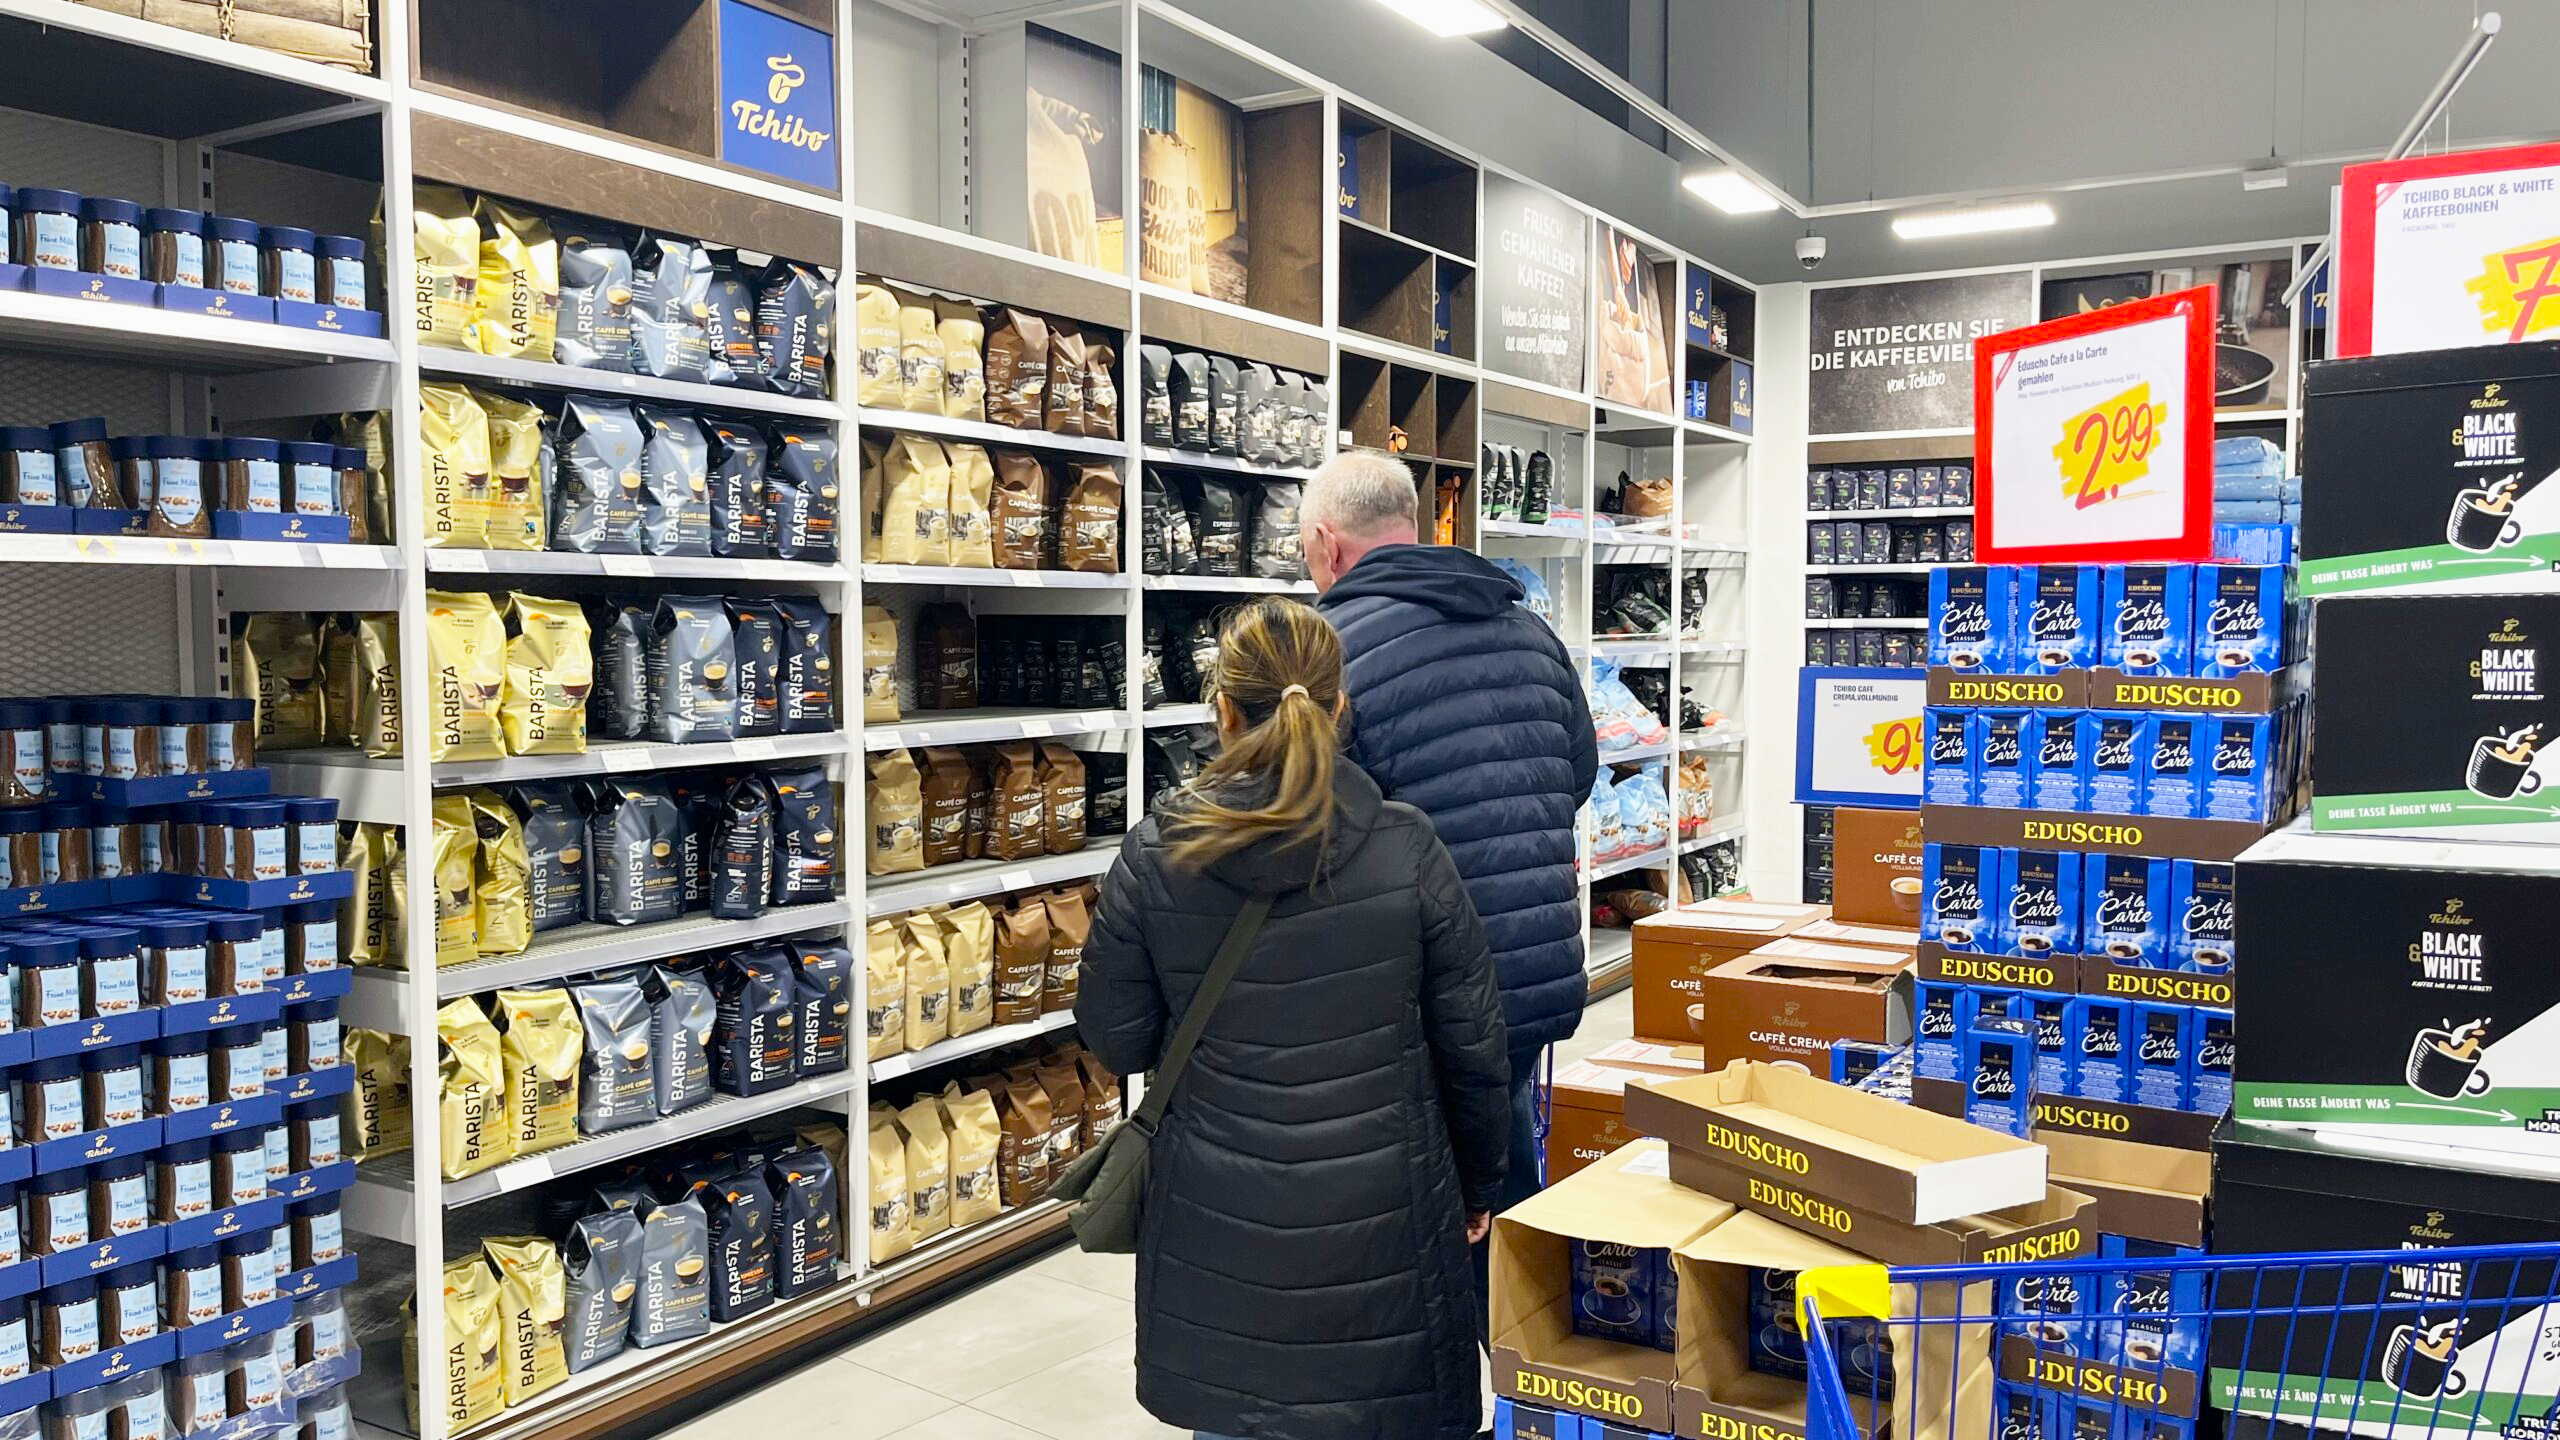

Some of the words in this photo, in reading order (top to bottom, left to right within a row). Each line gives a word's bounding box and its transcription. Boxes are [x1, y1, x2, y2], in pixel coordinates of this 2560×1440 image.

[731, 99, 830, 153] Tchibo
[2403, 189, 2449, 204] TCHIBO
[2453, 184, 2494, 199] BLACK
[2499, 183, 2508, 195] &
[2513, 179, 2554, 193] WHITE
[2403, 200, 2499, 220] KAFFEEBOHNEN
[1523, 207, 1563, 242] FRISCH
[1500, 230, 1576, 278] GEMAHLENER
[417, 256, 433, 331] BARISTA
[1518, 264, 1564, 300] KAFFEE?
[81, 291, 110, 301] Tchibo
[1688, 310, 1709, 330] Tchibo
[1834, 321, 1962, 347] ENTDECKEN
[788, 314, 808, 382] BARISTA
[1811, 352, 1844, 371] DIE
[1851, 343, 1974, 368] KAFFEEVIEL
[2018, 358, 2048, 372] Eduscho
[2051, 353, 2067, 366] Cafe
[2070, 354, 2074, 362] a
[2077, 350, 2083, 361] la
[2086, 346, 2107, 359] Carte
[1887, 378, 1906, 393] von
[1908, 371, 1946, 390] Tchibo
[2018, 372, 2053, 390] gemahlen
[1733, 402, 1751, 419] Tchibo
[2470, 398, 2509, 409] Tchibo
[2463, 412, 2516, 436] BLACK
[2452, 429, 2464, 446] &
[2463, 435, 2516, 458] WHITE
[728, 474, 742, 544] BARISTA
[792, 481, 809, 547] BARISTA
[2312, 572, 2339, 584] DEINE
[2341, 569, 2368, 581] TASSE
[2371, 559, 2408, 576] ÄNDERT
[2411, 559, 2433, 570] WAS
[1939, 609, 1992, 637] Carte
[2028, 608, 2082, 635] Carte
[2114, 607, 2171, 635] Carte
[2207, 607, 2266, 635] Carte
[2489, 633, 2527, 642] Tchibo
[2481, 649, 2535, 669] BLACK
[789, 654, 803, 719] BARISTA
[2470, 661, 2481, 678] &
[2482, 671, 2535, 691] WHITE
[378, 664, 397, 743] BARISTA
[529, 667, 545, 740] BARISTA
[1948, 681, 2064, 701] EDUSCHO
[2115, 684, 2241, 707] EDUSCHO
[443, 666, 460, 745] BARISTA
[1983, 743, 2022, 763] Carte
[2152, 748, 2194, 770] Carte
[2328, 810, 2355, 819] DEINE
[2358, 807, 2385, 816] TASSE
[2389, 803, 2426, 815] ÄNDERT
[2430, 803, 2452, 813] WAS
[2023, 821, 2143, 846] EDUSCHO
[1874, 853, 1906, 864] CAFFÈ
[534, 848, 548, 919] BARISTA
[629, 840, 644, 912] BARISTA
[367, 867, 384, 947] BARISTA
[1932, 886, 1984, 912] Carte
[2009, 893, 2063, 919] Carte
[2096, 898, 2153, 926] Carte
[2429, 914, 2473, 925] Tchibo
[2422, 931, 2482, 956] BLACK
[1941, 959, 2054, 986] EDUSCHO
[2409, 944, 2421, 962] &
[2423, 956, 2482, 981] WHITE
[1671, 979, 1701, 990] CAFFÈ
[2107, 973, 2231, 1003] EDUSCHO
[209, 1012, 239, 1025] Tchibo
[1771, 1016, 1808, 1028] Tchibo
[750, 1014, 765, 1082] BARISTA
[1750, 1031, 1786, 1045] CAFFÈ
[1789, 1036, 1831, 1050] CREMA
[1769, 1045, 1811, 1055] VOLLMUNDIG
[1973, 1073, 2016, 1094] Carte
[361, 1068, 380, 1148] BARISTA
[522, 1065, 538, 1141] BARISTA
[2253, 1096, 2283, 1108] DEINE
[2286, 1097, 2317, 1108] TASSE
[2320, 1096, 2362, 1109] ÄNDERT
[2366, 1098, 2390, 1109] WAS
[465, 1082, 481, 1161] BARISTA
[1706, 1123, 1809, 1175] EDUSCHO
[1749, 1178, 1852, 1234] EDUSCHO
[214, 1223, 242, 1237] Tchibo
[2410, 1225, 2454, 1239] Tchibo
[793, 1219, 805, 1285] BARISTA
[726, 1239, 742, 1307] BARISTA
[2132, 1321, 2161, 1332] CLASSIC
[517, 1307, 535, 1388] BARISTA
[450, 1342, 467, 1421] BARISTA
[1516, 1370, 1643, 1418] EDUSCHO
